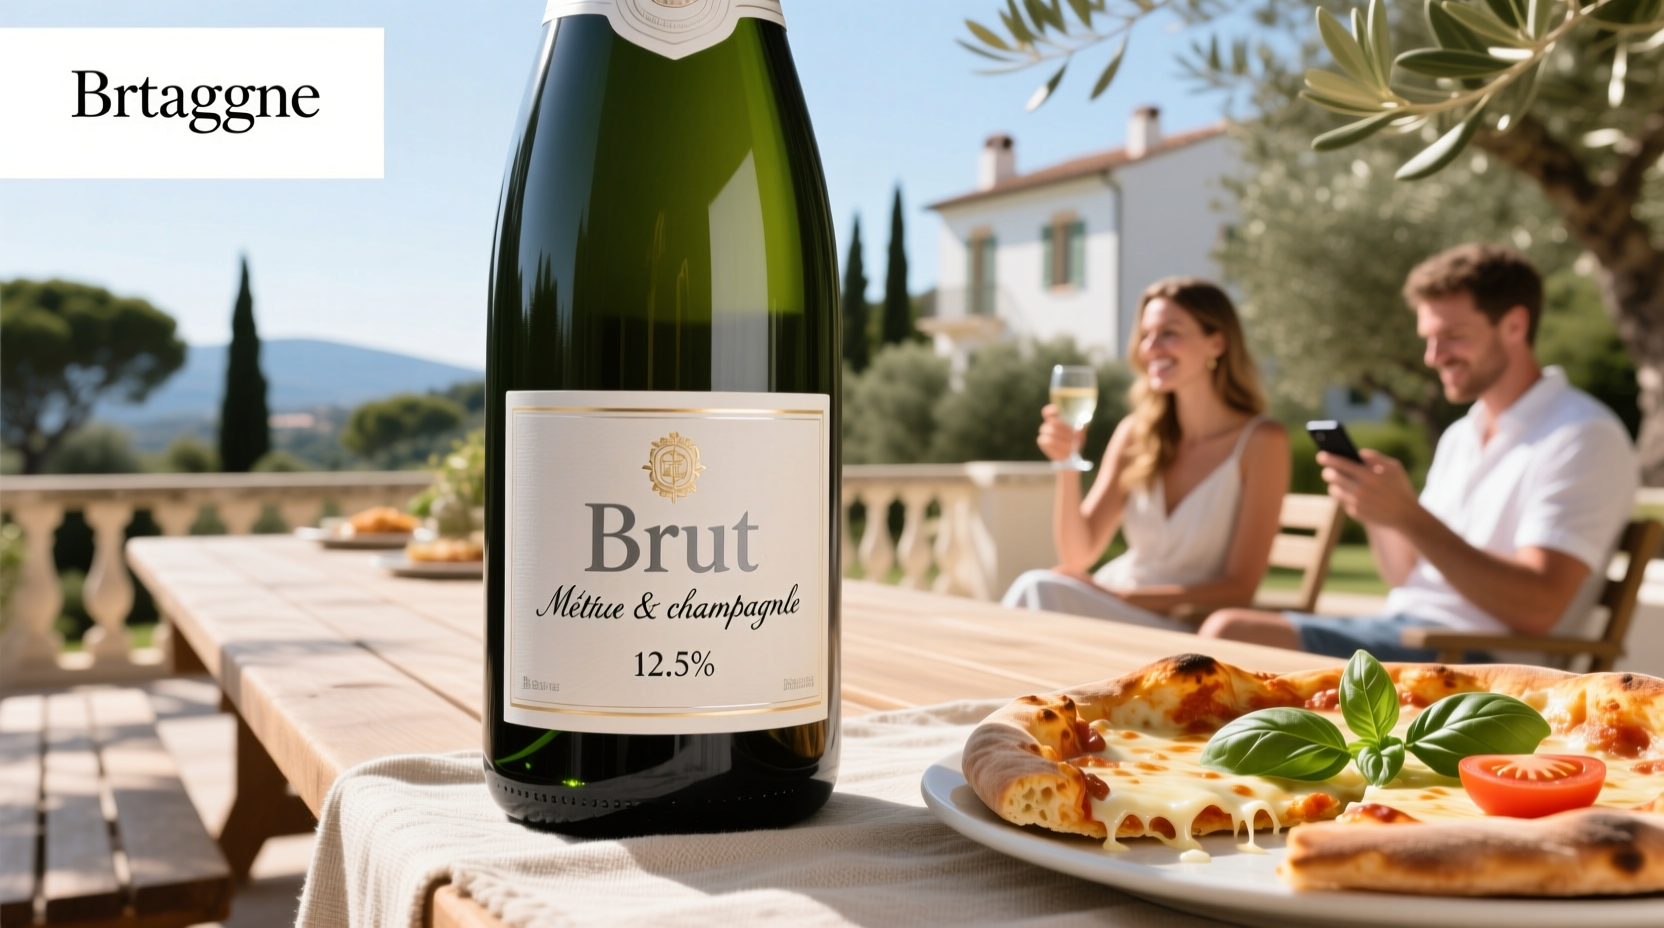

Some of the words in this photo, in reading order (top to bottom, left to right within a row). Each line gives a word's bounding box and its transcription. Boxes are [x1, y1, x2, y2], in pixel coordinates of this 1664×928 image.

[584, 502, 759, 573] Brut
[633, 591, 661, 620] &
[634, 650, 715, 678] 12.5%
